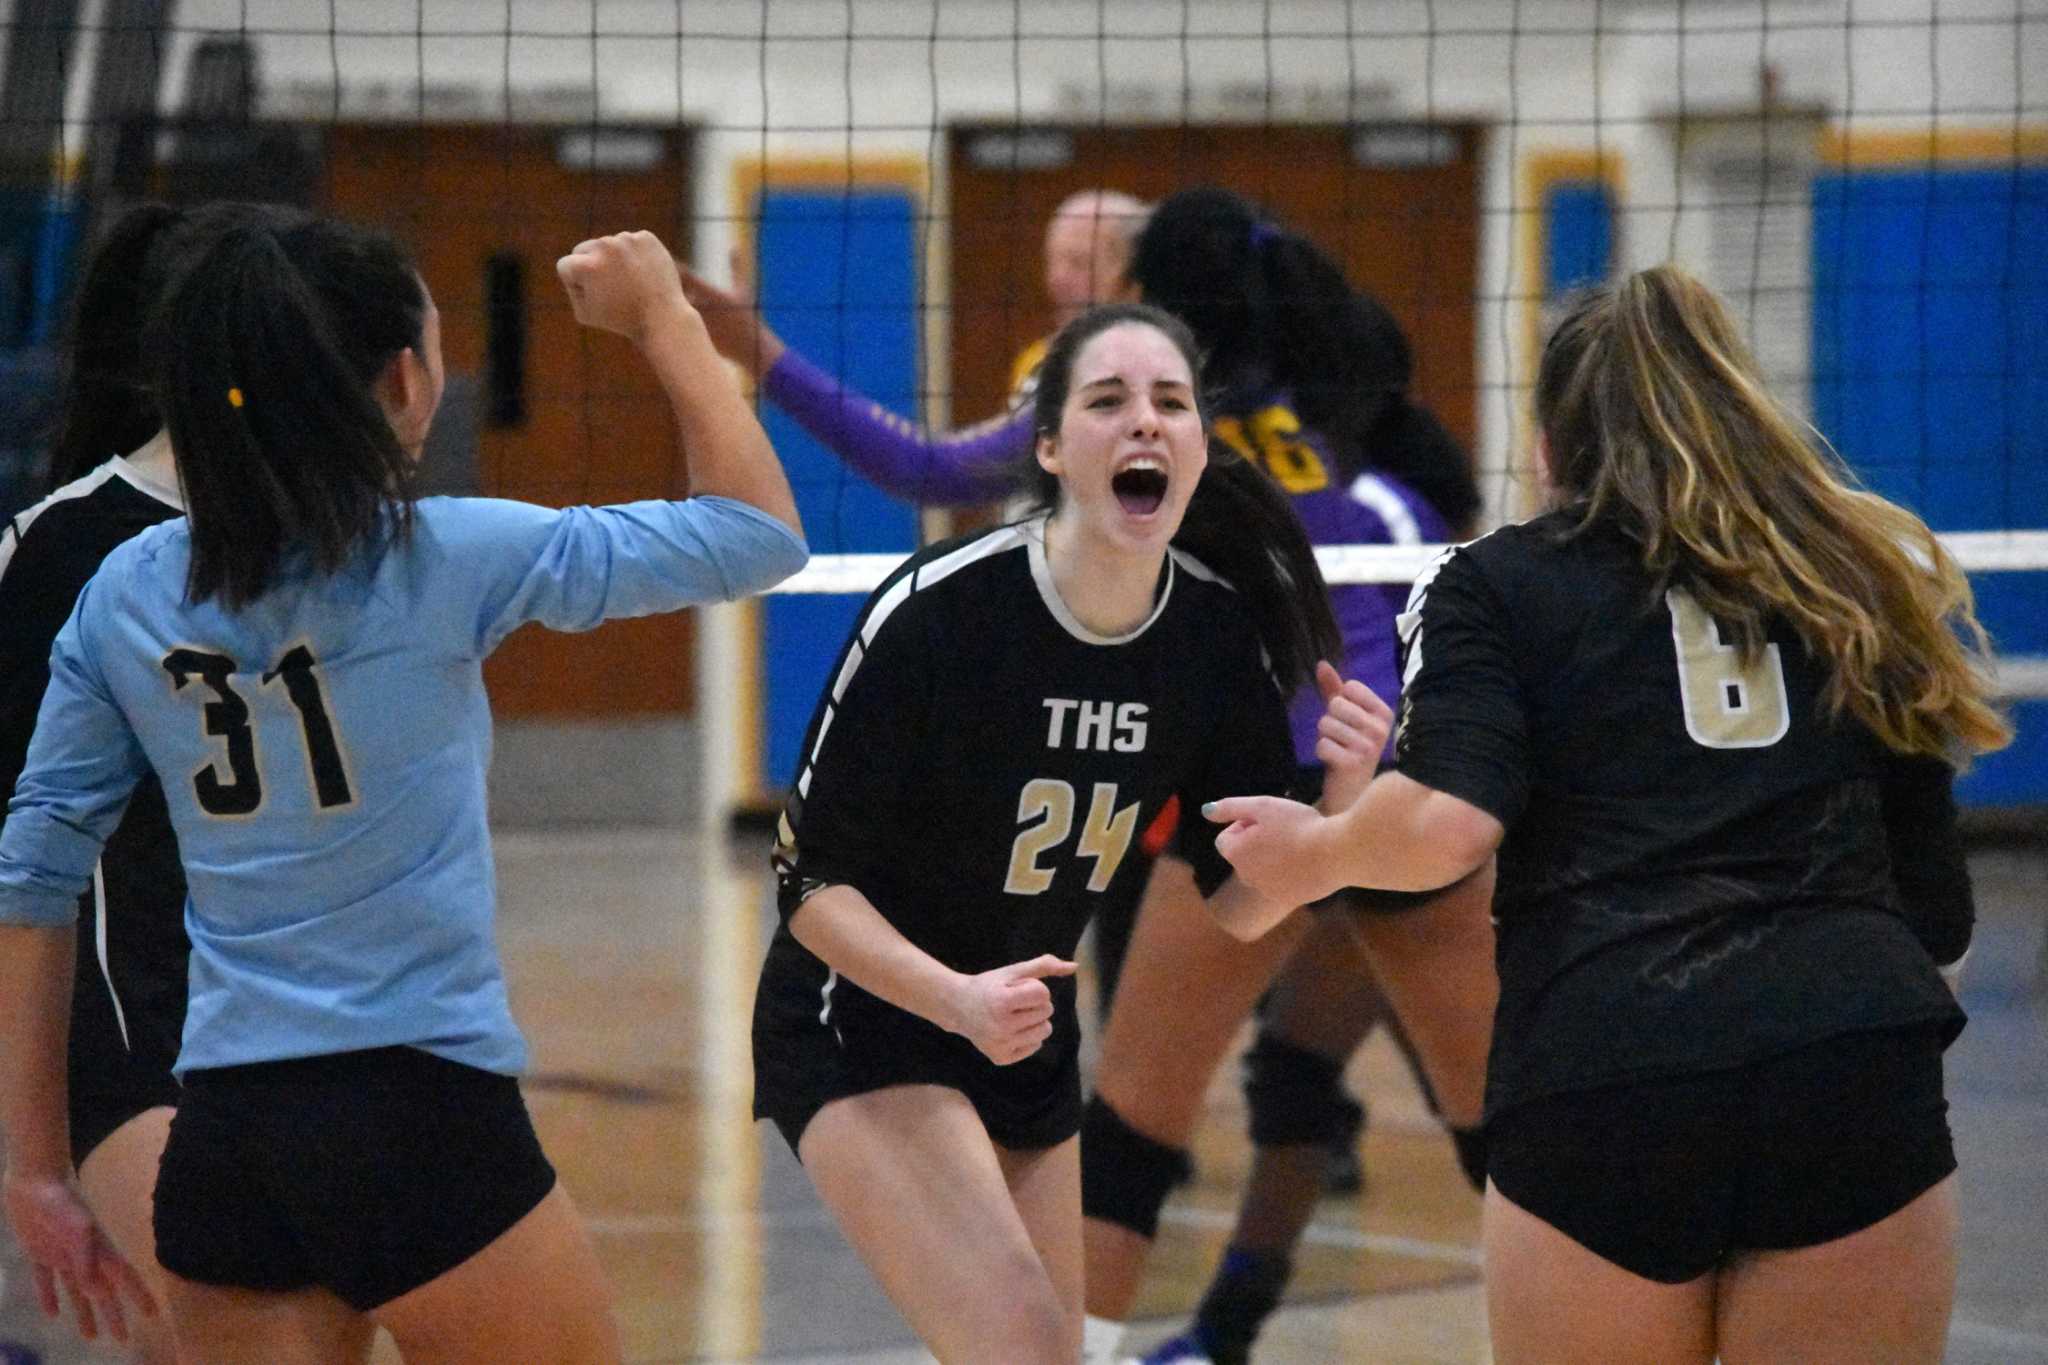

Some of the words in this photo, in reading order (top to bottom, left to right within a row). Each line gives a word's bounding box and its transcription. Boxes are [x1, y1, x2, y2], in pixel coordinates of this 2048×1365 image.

[160, 640, 357, 817] 31
[1042, 698, 1149, 752] THS
[1664, 583, 1791, 749] 6
[1003, 778, 1141, 895] 24
